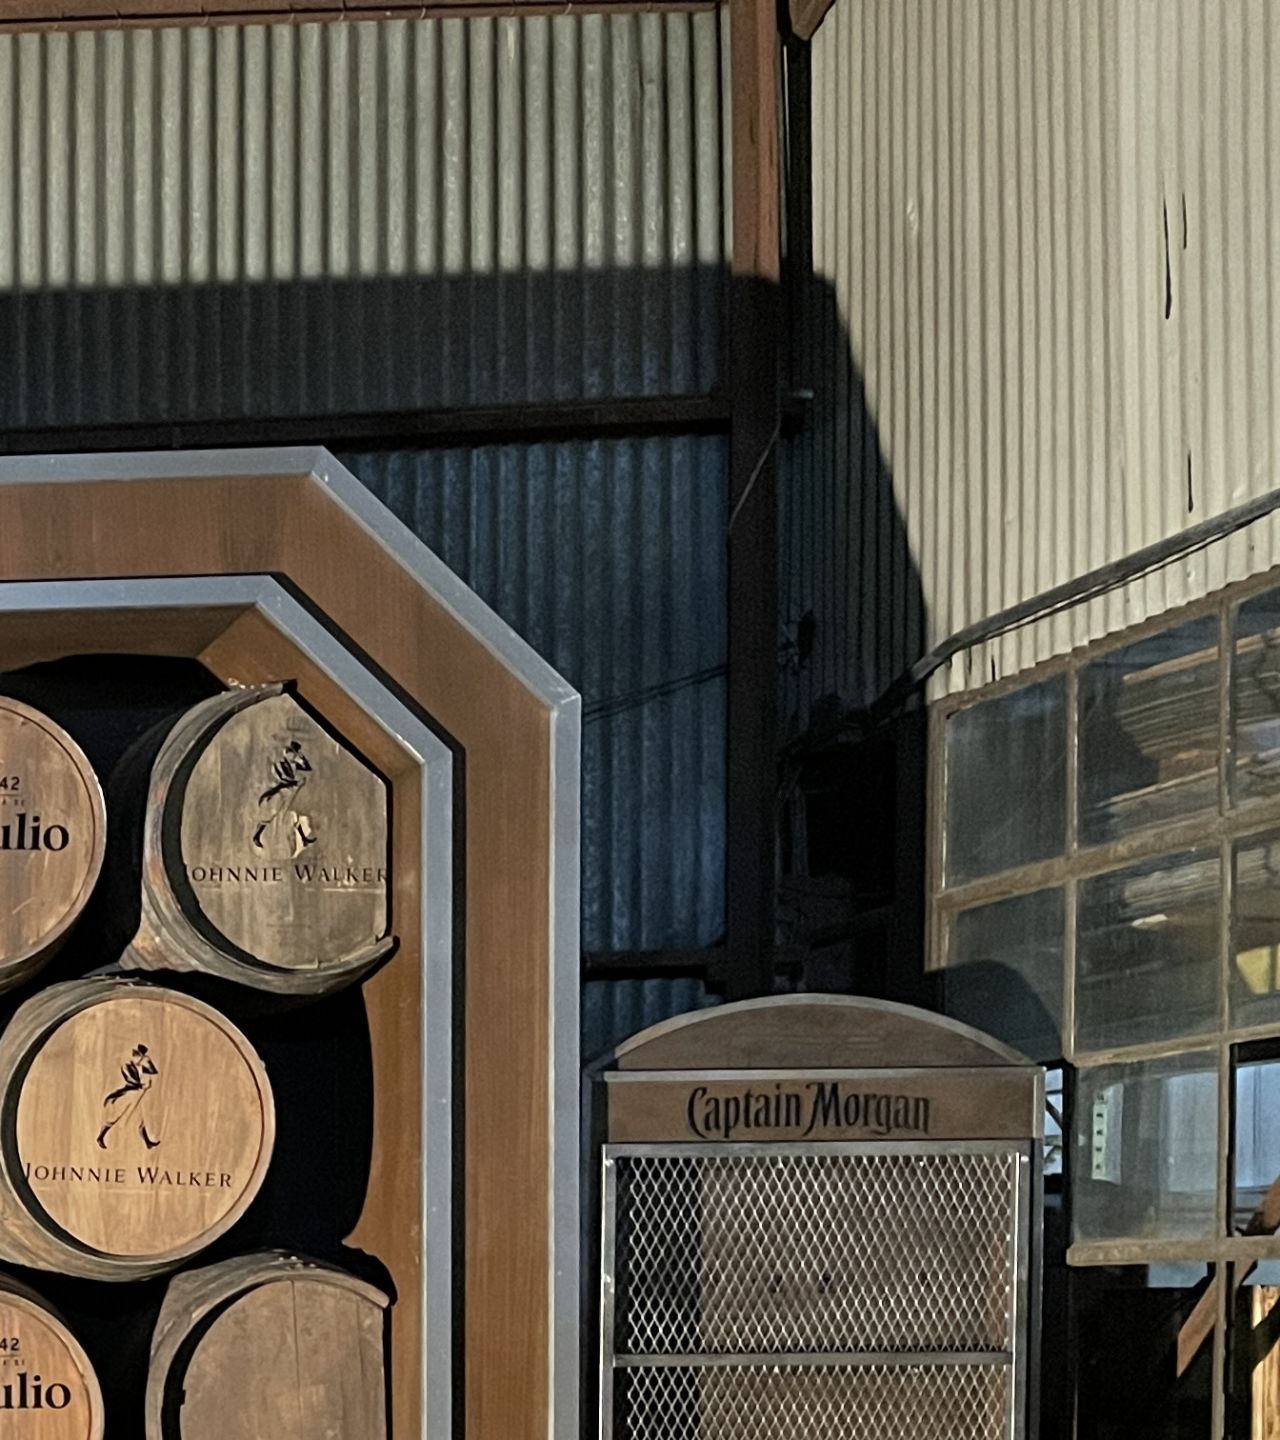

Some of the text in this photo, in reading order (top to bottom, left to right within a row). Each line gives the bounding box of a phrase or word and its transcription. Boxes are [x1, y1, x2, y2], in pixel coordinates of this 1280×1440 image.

[191, 866, 284, 883] OHNNIE
[687, 1081, 930, 1140] Captain Morgan
[24, 1162, 232, 1188] JOHNNIE WALKER
